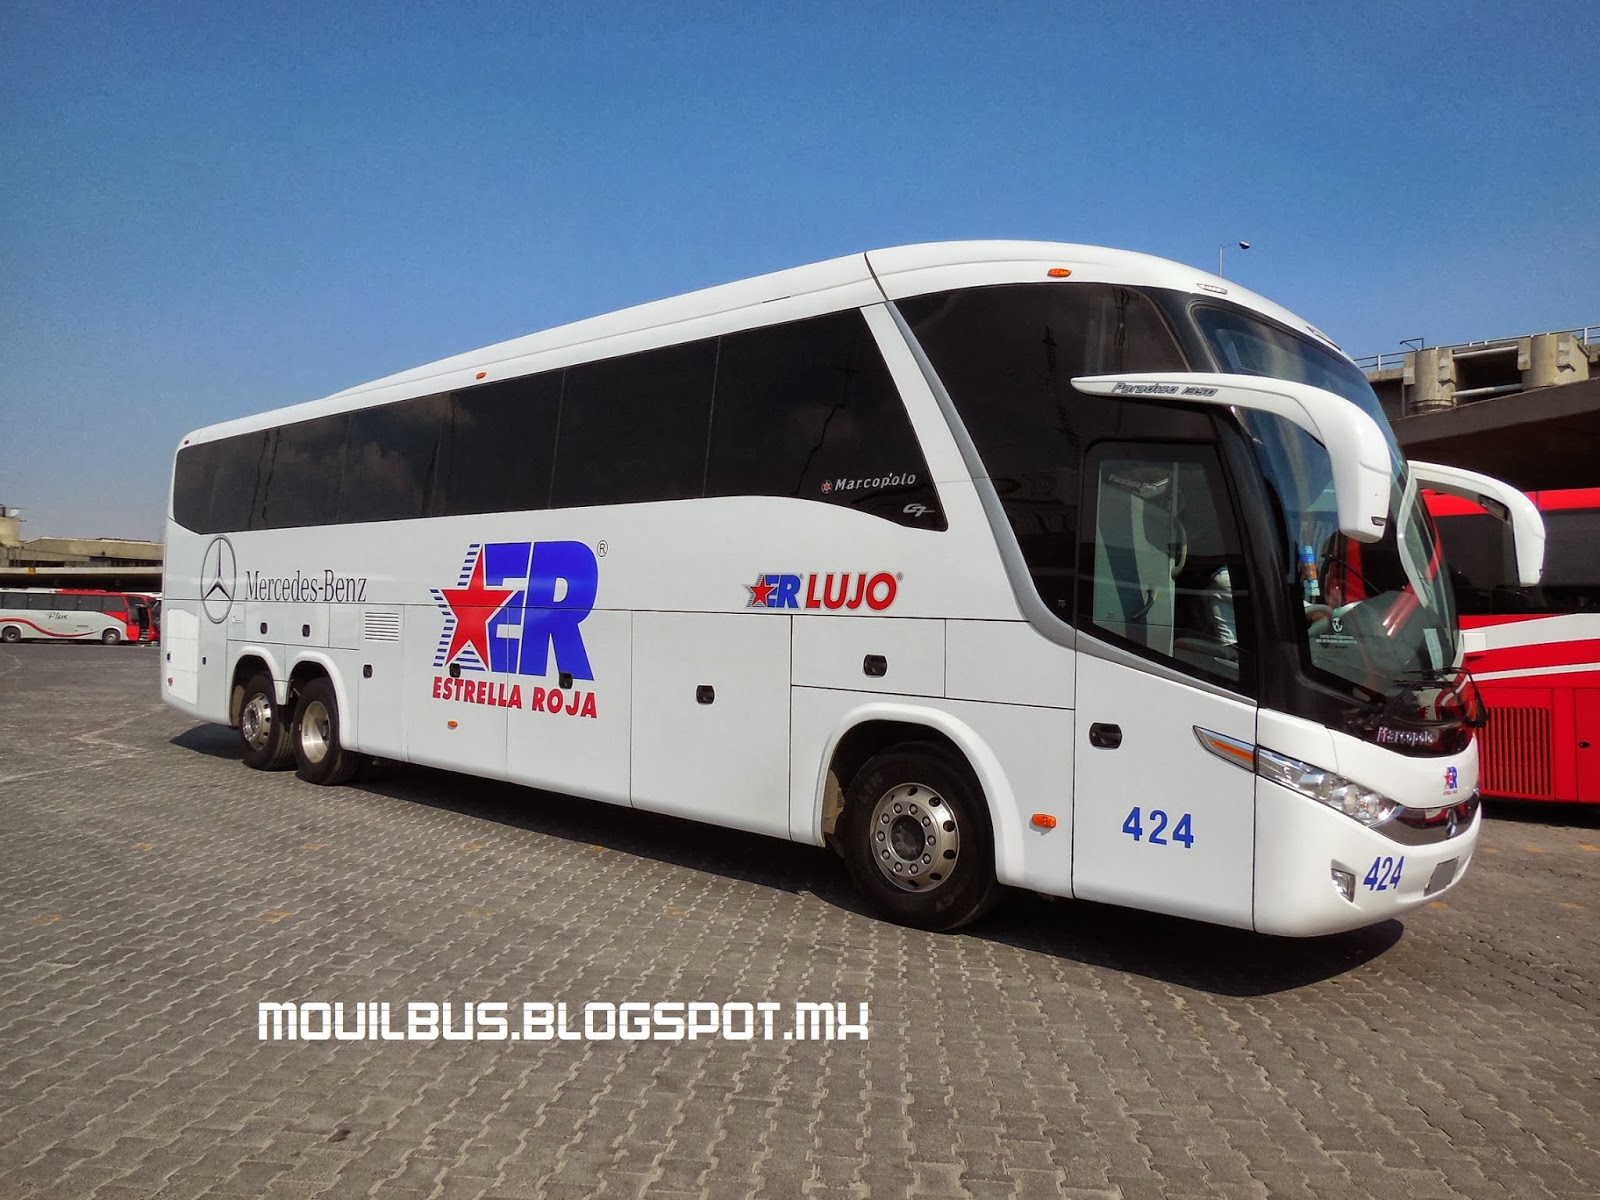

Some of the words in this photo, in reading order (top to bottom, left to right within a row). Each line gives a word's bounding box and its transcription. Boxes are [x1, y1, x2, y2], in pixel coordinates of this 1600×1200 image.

[1111, 382, 1180, 394] Paradiso
[835, 473, 917, 491] Marcopolo
[244, 569, 368, 602] Mercedes-Benz
[805, 572, 898, 611] LUJO
[432, 676, 523, 709] ESTRELLA
[531, 687, 598, 719] ROJA
[1122, 807, 1195, 849] 424
[1363, 857, 1404, 891] 424
